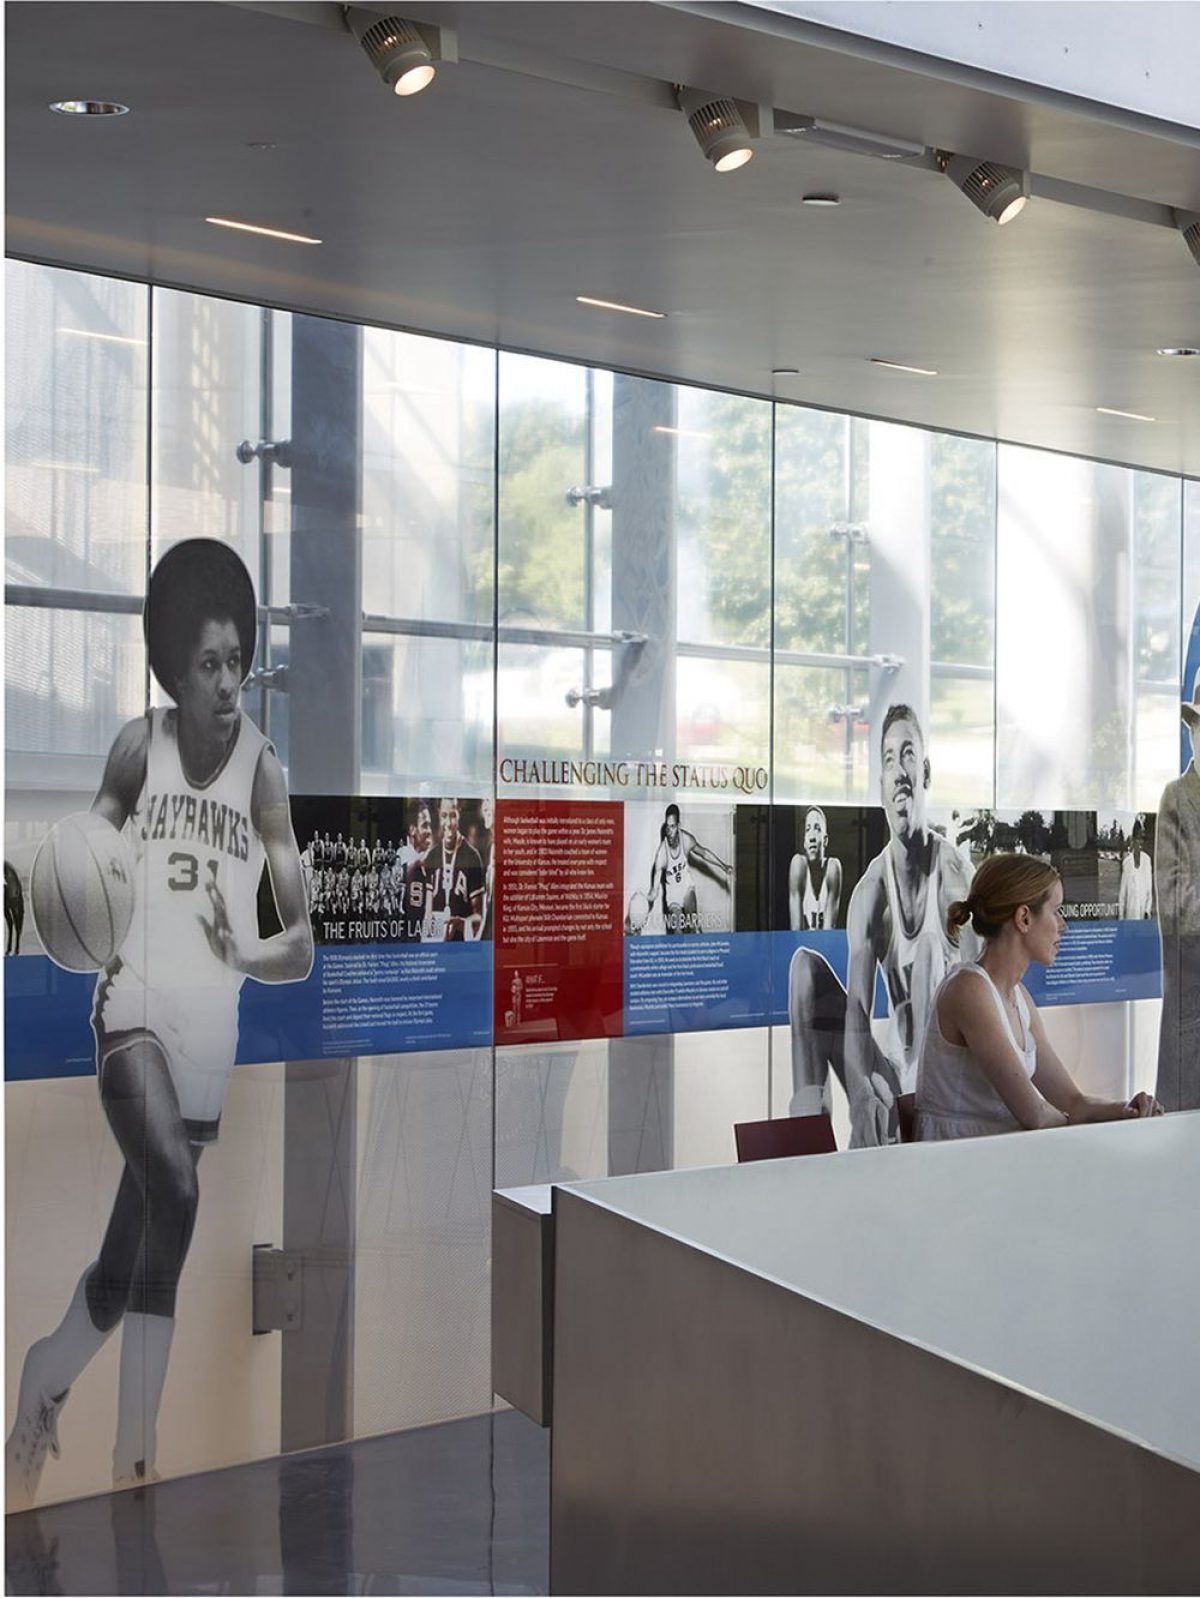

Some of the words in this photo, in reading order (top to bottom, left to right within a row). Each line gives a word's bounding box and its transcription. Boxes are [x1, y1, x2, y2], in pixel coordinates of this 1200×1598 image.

[499, 758, 630, 787] CHALLENGING
[635, 762, 668, 787] THE
[671, 765, 729, 788] STATUS
[731, 767, 769, 794] QUO
[141, 793, 250, 863] JAYHAWKS
[323, 921, 346, 940] THE
[348, 920, 388, 940] FRUITS
[389, 919, 404, 938] OF
